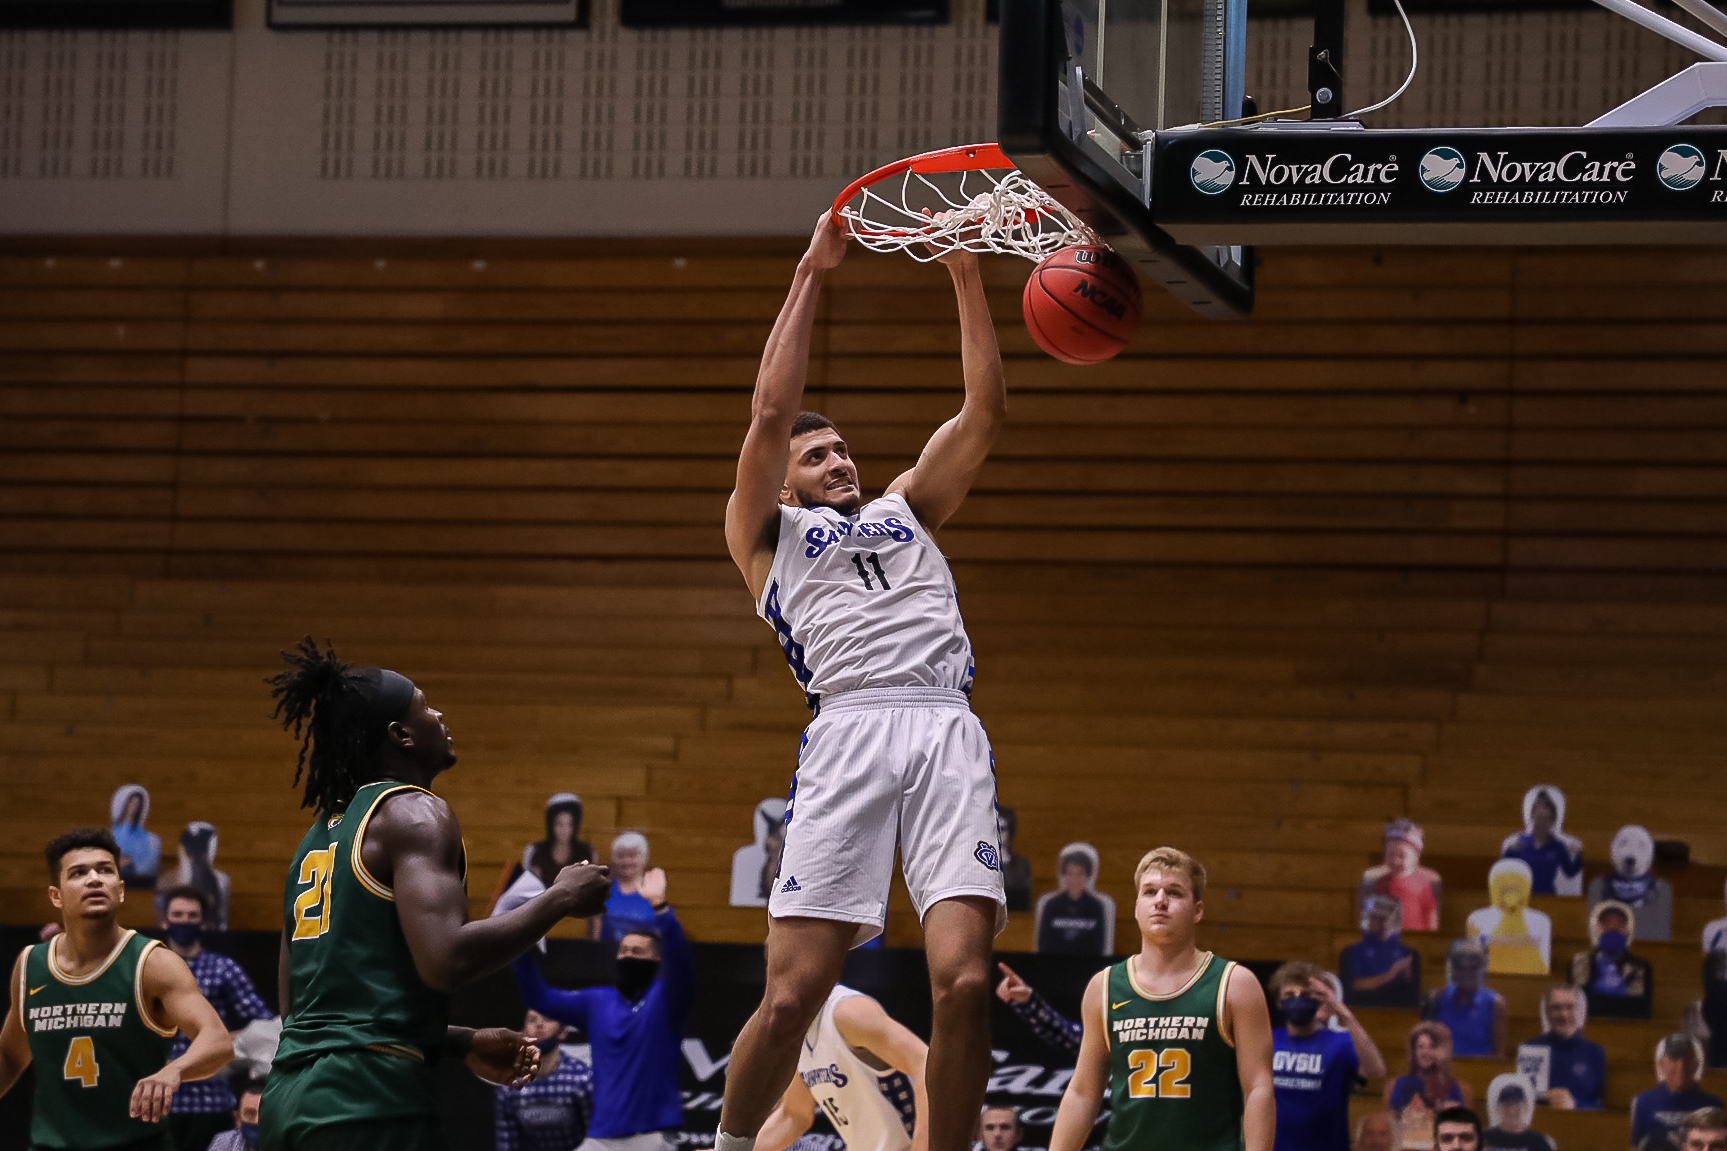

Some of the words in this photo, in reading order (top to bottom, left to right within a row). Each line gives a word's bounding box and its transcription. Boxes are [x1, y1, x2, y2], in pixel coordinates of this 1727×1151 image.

[1240, 193, 1391, 206] REHABILITATION
[1470, 191, 1628, 204] REHABILITATION
[1073, 279, 1127, 321] NCAA
[851, 552, 891, 590] 11
[292, 841, 338, 941] 21
[29, 1003, 127, 1019] NORTHERN
[34, 1015, 123, 1032] MICHIGAN
[1113, 1017, 1209, 1031] NORTHERN
[1119, 1028, 1205, 1042] MICHIGAN
[64, 1036, 99, 1087] 4
[1273, 1051, 1322, 1074] GVSU
[1128, 1048, 1191, 1098] 22
